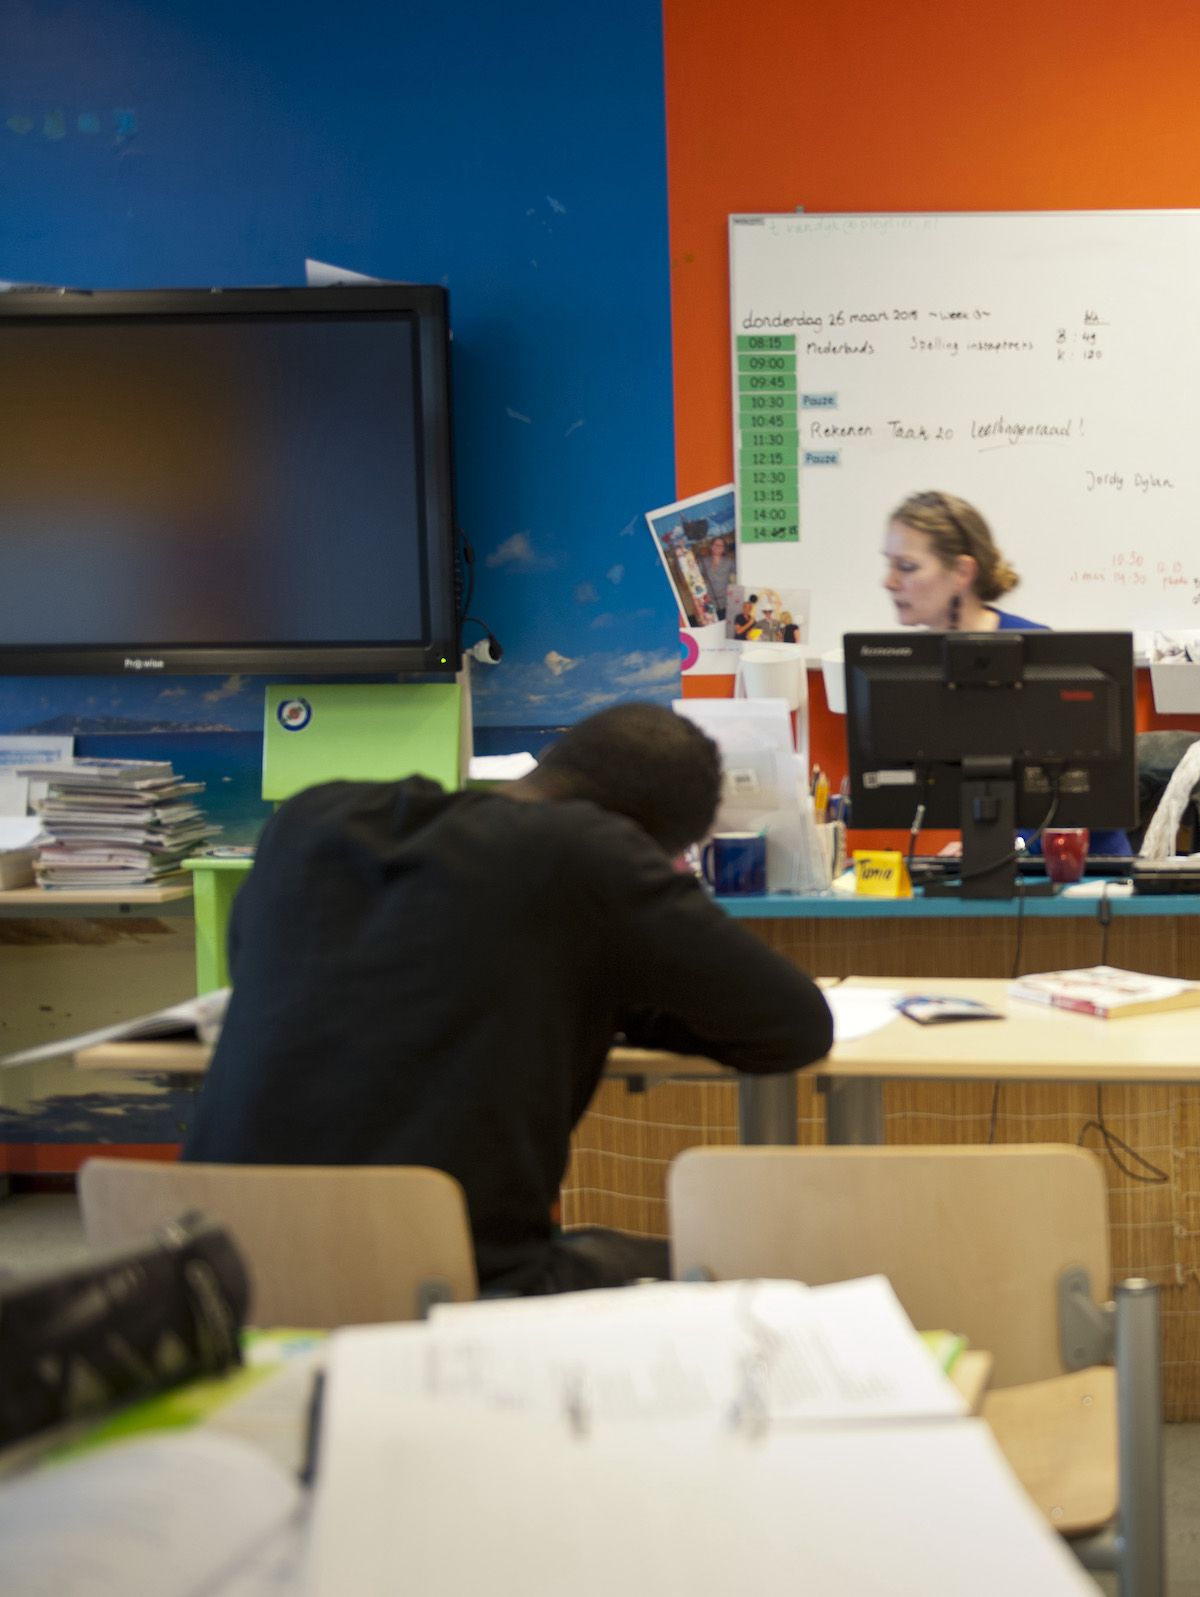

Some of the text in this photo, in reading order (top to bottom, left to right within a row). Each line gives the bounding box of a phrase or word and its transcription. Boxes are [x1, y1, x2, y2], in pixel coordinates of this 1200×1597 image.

[743, 309, 823, 333] donderdag
[829, 310, 845, 326] 26
[750, 337, 782, 348] 08:15
[910, 336, 959, 357] Spelling
[750, 358, 785, 369] 09:00
[750, 376, 785, 388] 09:45
[751, 397, 784, 408] 10:30
[752, 416, 784, 427] 10:45
[811, 421, 873, 439] Rekenen
[888, 420, 928, 441] Taak
[935, 428, 954, 440] 20
[753, 434, 783, 445] 11:30
[753, 453, 783, 464] 12:15
[805, 453, 836, 463] Pauze
[753, 473, 786, 484] 12:30
[1085, 470, 1174, 492] Jordy Dylan
[753, 491, 784, 501] 13:15
[754, 510, 786, 520] 14:00
